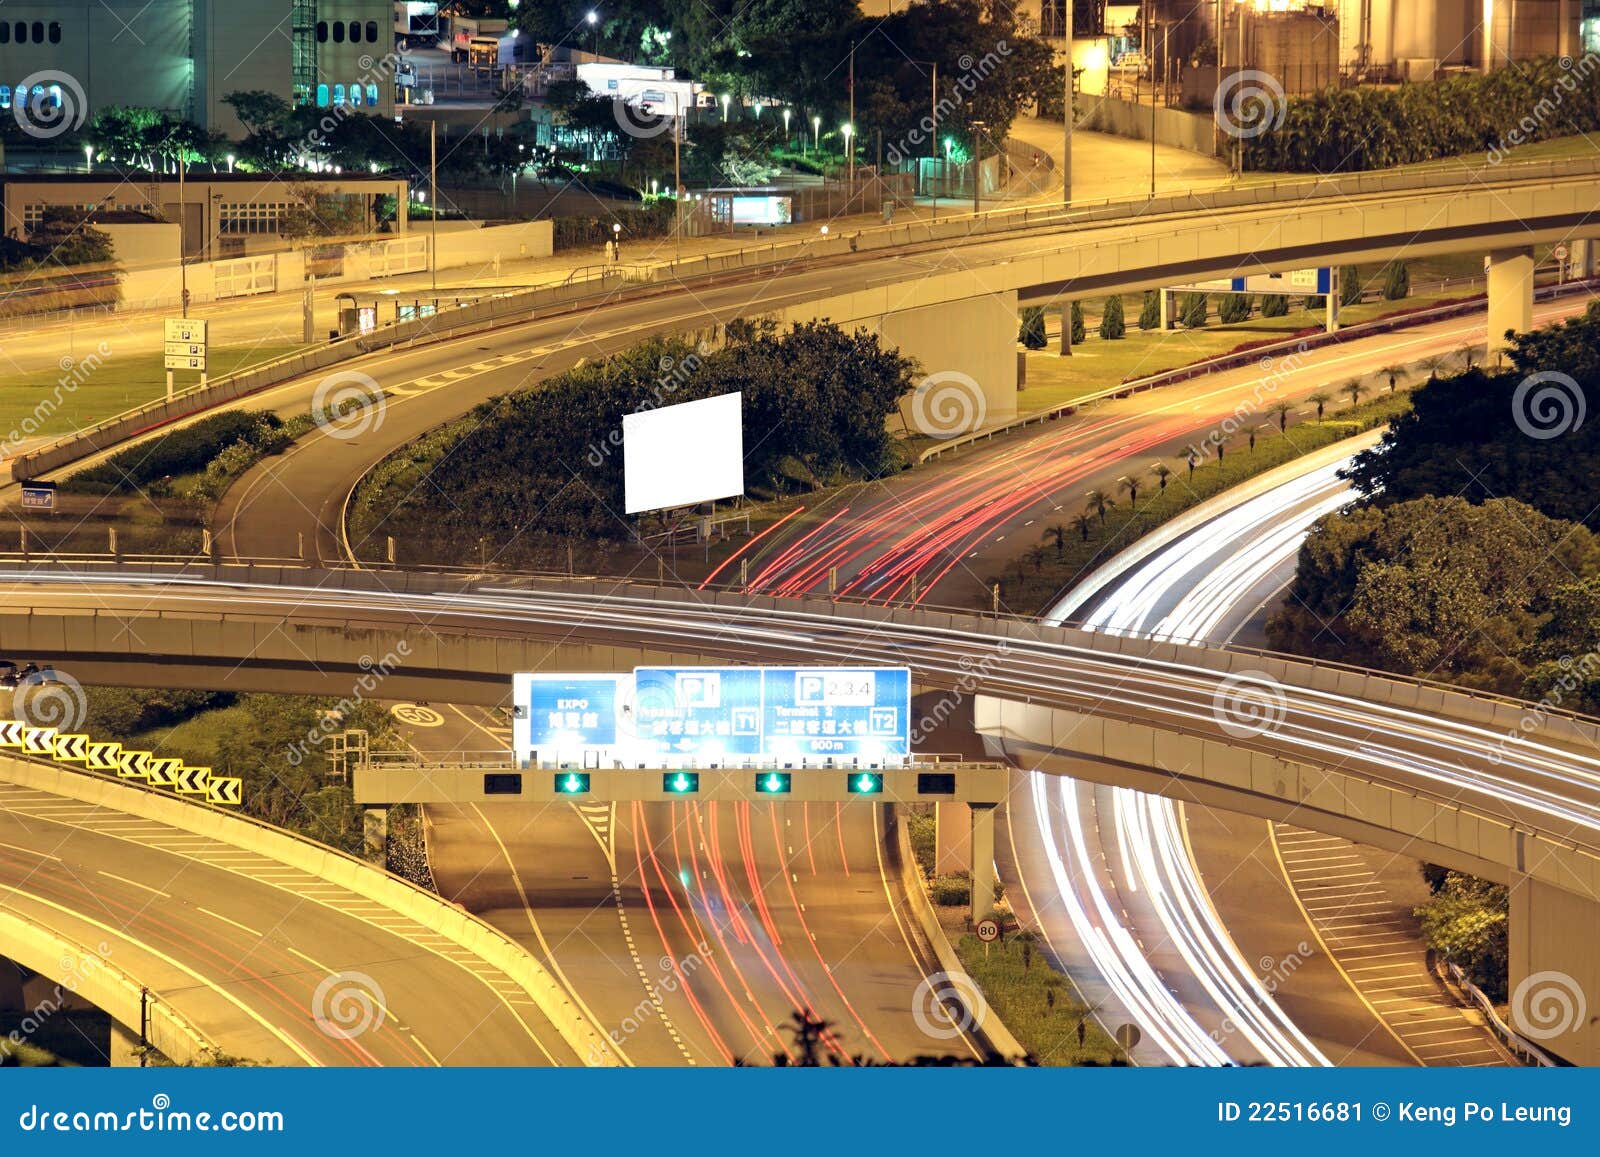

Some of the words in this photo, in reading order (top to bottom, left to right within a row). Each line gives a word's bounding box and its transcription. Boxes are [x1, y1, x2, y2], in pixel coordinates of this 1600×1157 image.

[557, 699, 589, 710] EXPO
[398, 709, 434, 722] 50
[873, 713, 894, 729] T2
[980, 926, 996, 936] 80
